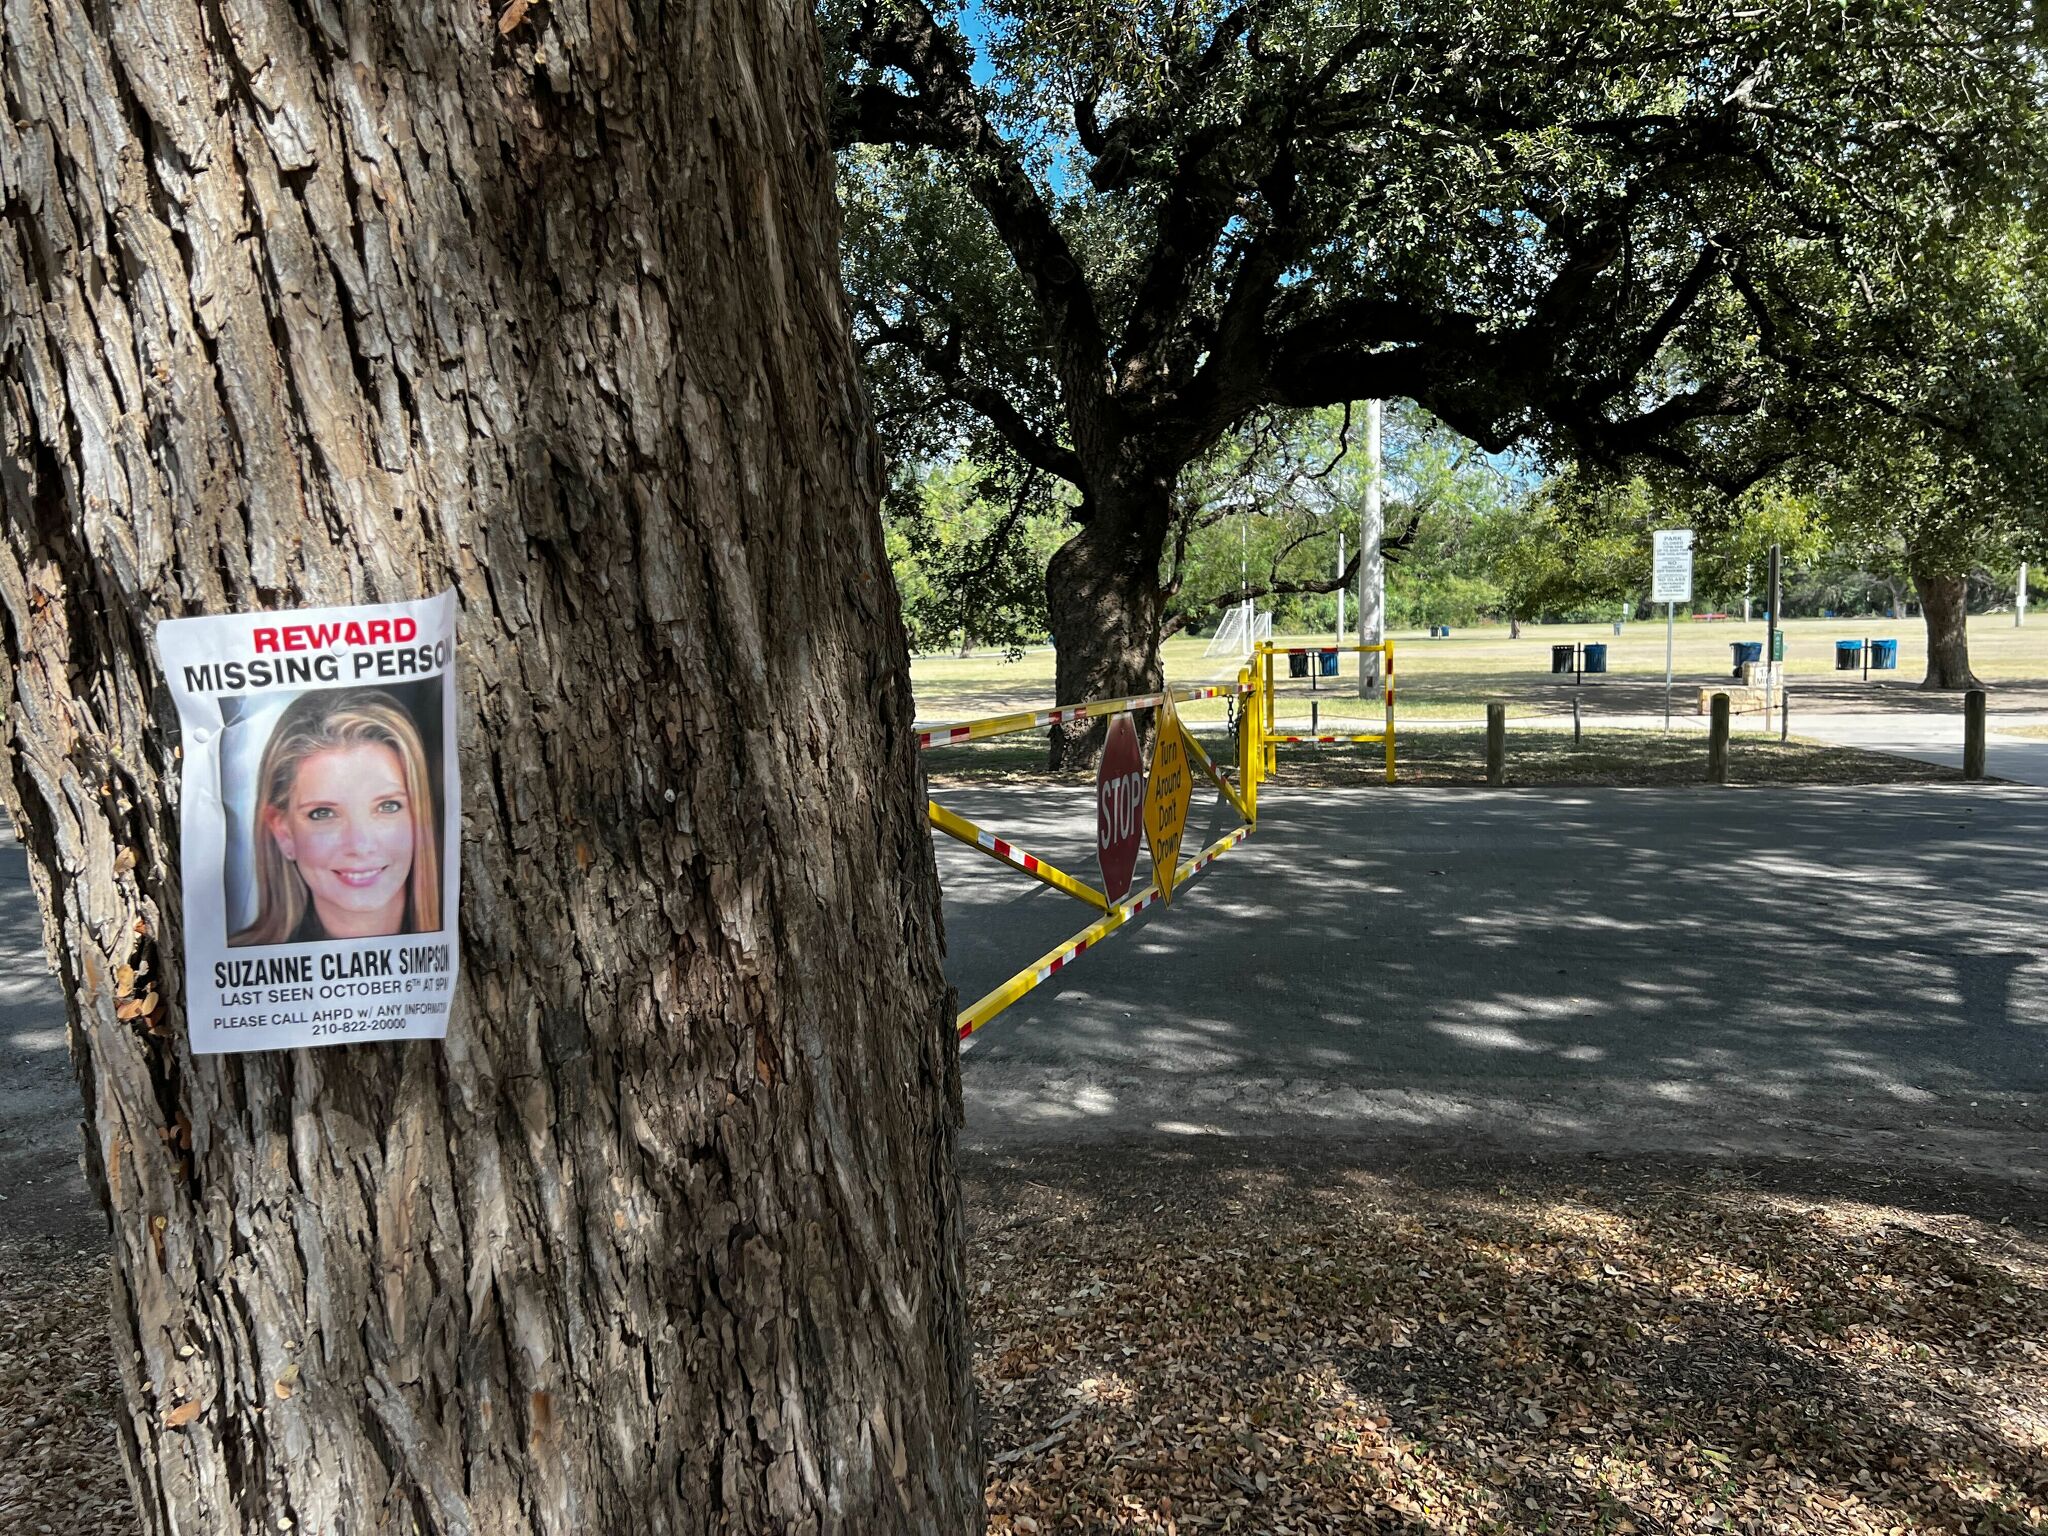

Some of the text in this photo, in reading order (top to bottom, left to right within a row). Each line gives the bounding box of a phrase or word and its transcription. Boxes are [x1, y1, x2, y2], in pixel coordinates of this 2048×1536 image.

[253, 617, 417, 654] REWARD
[183, 654, 339, 692] MISSING
[1160, 740, 1177, 766] Turn
[1155, 765, 1181, 801] Around
[1101, 771, 1140, 850] STOP
[1158, 803, 1177, 832] Don't
[1156, 832, 1179, 865] Drown
[215, 955, 313, 989] SUZANNE
[321, 949, 394, 979] CLARK
[221, 991, 262, 1007] LAST
[268, 988, 313, 1003] SEEN
[319, 980, 401, 999] OCTOBER
[423, 978, 434, 992] AT
[214, 1014, 267, 1030] PLEASE
[271, 1012, 308, 1026] CALL
[312, 1008, 353, 1022] AHPD
[377, 1004, 402, 1017] ANY
